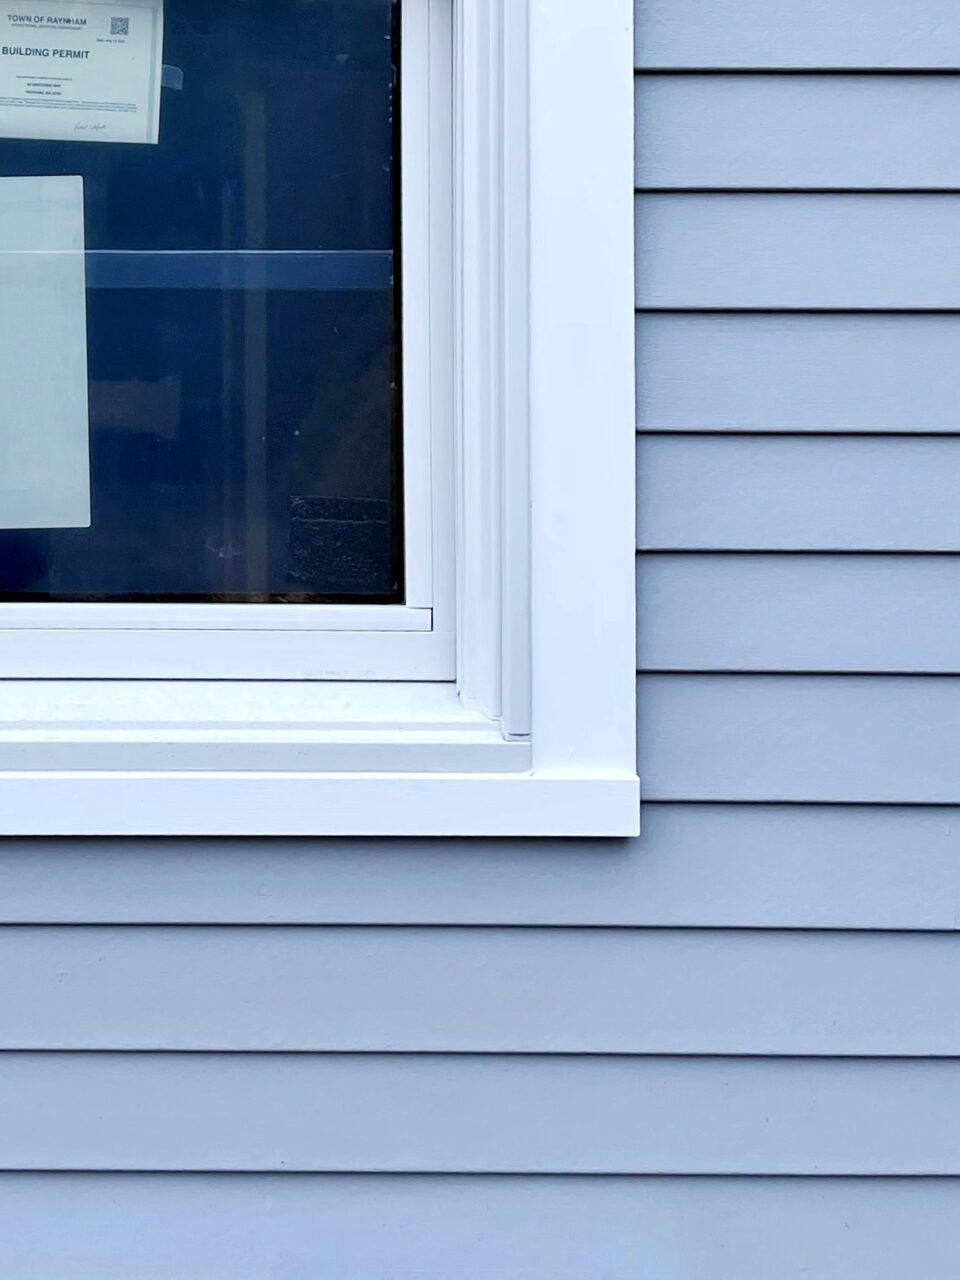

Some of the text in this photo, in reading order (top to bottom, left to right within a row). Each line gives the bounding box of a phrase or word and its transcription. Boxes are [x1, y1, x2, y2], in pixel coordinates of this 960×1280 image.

[7, 14, 32, 23] TOWN
[33, 15, 45, 24] OF
[1, 46, 90, 59] BUILDING PERMIT
